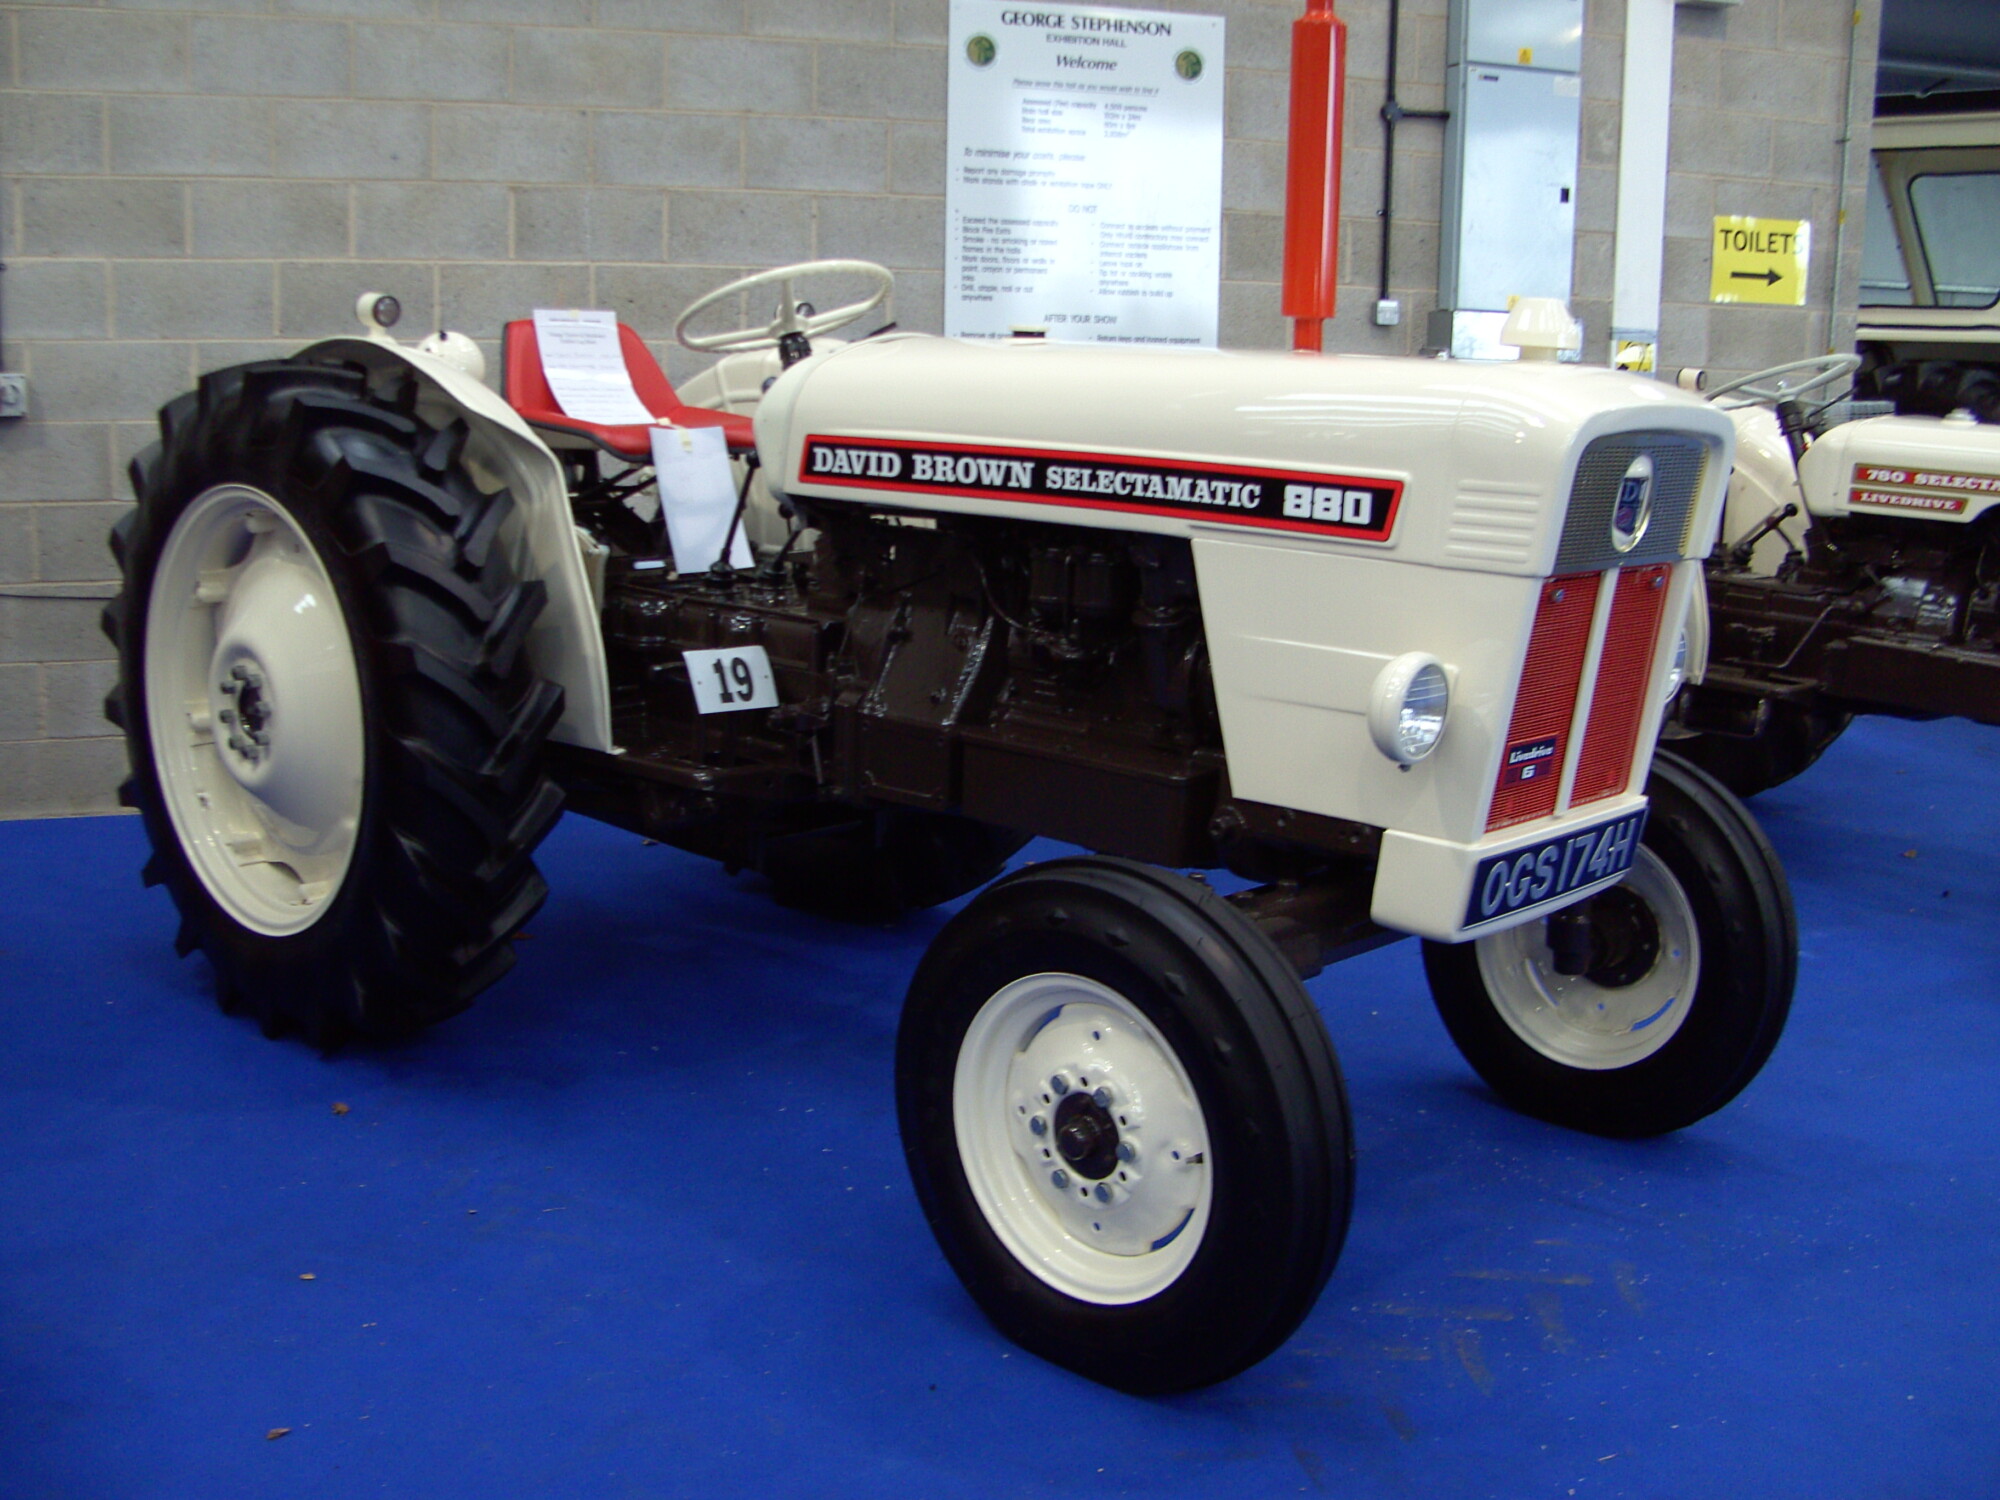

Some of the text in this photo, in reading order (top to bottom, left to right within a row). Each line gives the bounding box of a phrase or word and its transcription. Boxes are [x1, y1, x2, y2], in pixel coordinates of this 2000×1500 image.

[1001, 10, 1172, 37] GEORGE STEPHENSON
[1046, 34, 1127, 48] EXHIBITION HALL
[1056, 54, 1118, 71] Welcome
[1068, 204, 1098, 214] DO NOT
[1044, 314, 1118, 325] AFTER YOUR SHOW
[1867, 469, 1906, 484] 780
[812, 446, 1373, 525] DAVID BROWN SELECTAMATIC 880
[1860, 492, 1957, 510] LIVEDRIVE
[712, 656, 754, 704] 19
[1521, 764, 1537, 780] 6
